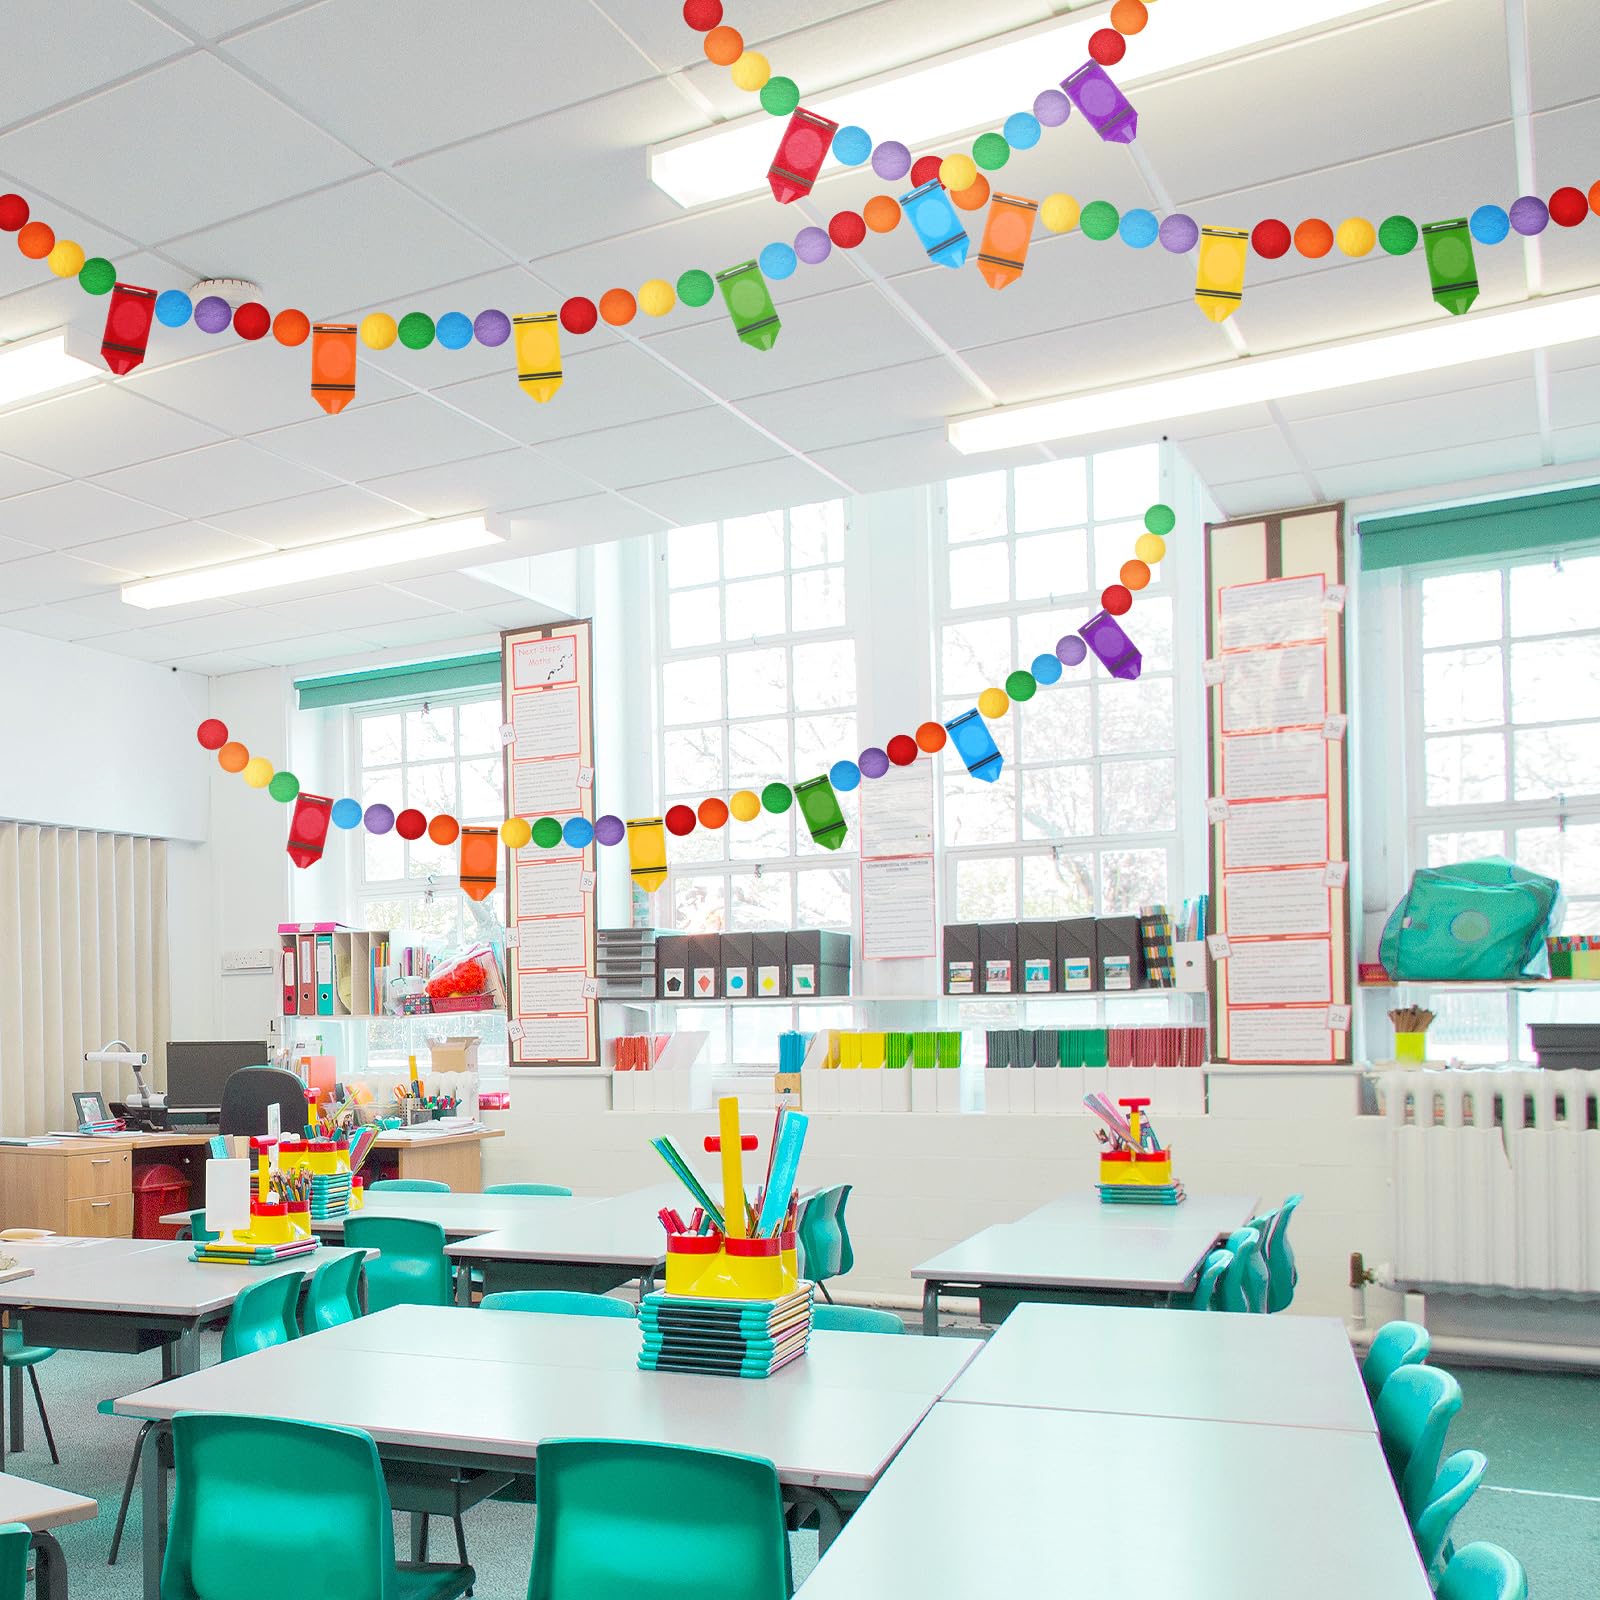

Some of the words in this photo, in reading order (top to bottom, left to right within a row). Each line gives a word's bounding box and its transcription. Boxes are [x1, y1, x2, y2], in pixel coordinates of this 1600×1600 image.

[518, 648, 536, 656] Next
[540, 645, 560, 653] Steps
[528, 657, 551, 665] Maths
[580, 774, 589, 783] 4c
[583, 878, 592, 886] 3b
[509, 934, 518, 942] 3c
[1214, 943, 1227, 952] 2a
[1332, 1013, 1345, 1022] 2b
[511, 1027, 520, 1035] 2b
